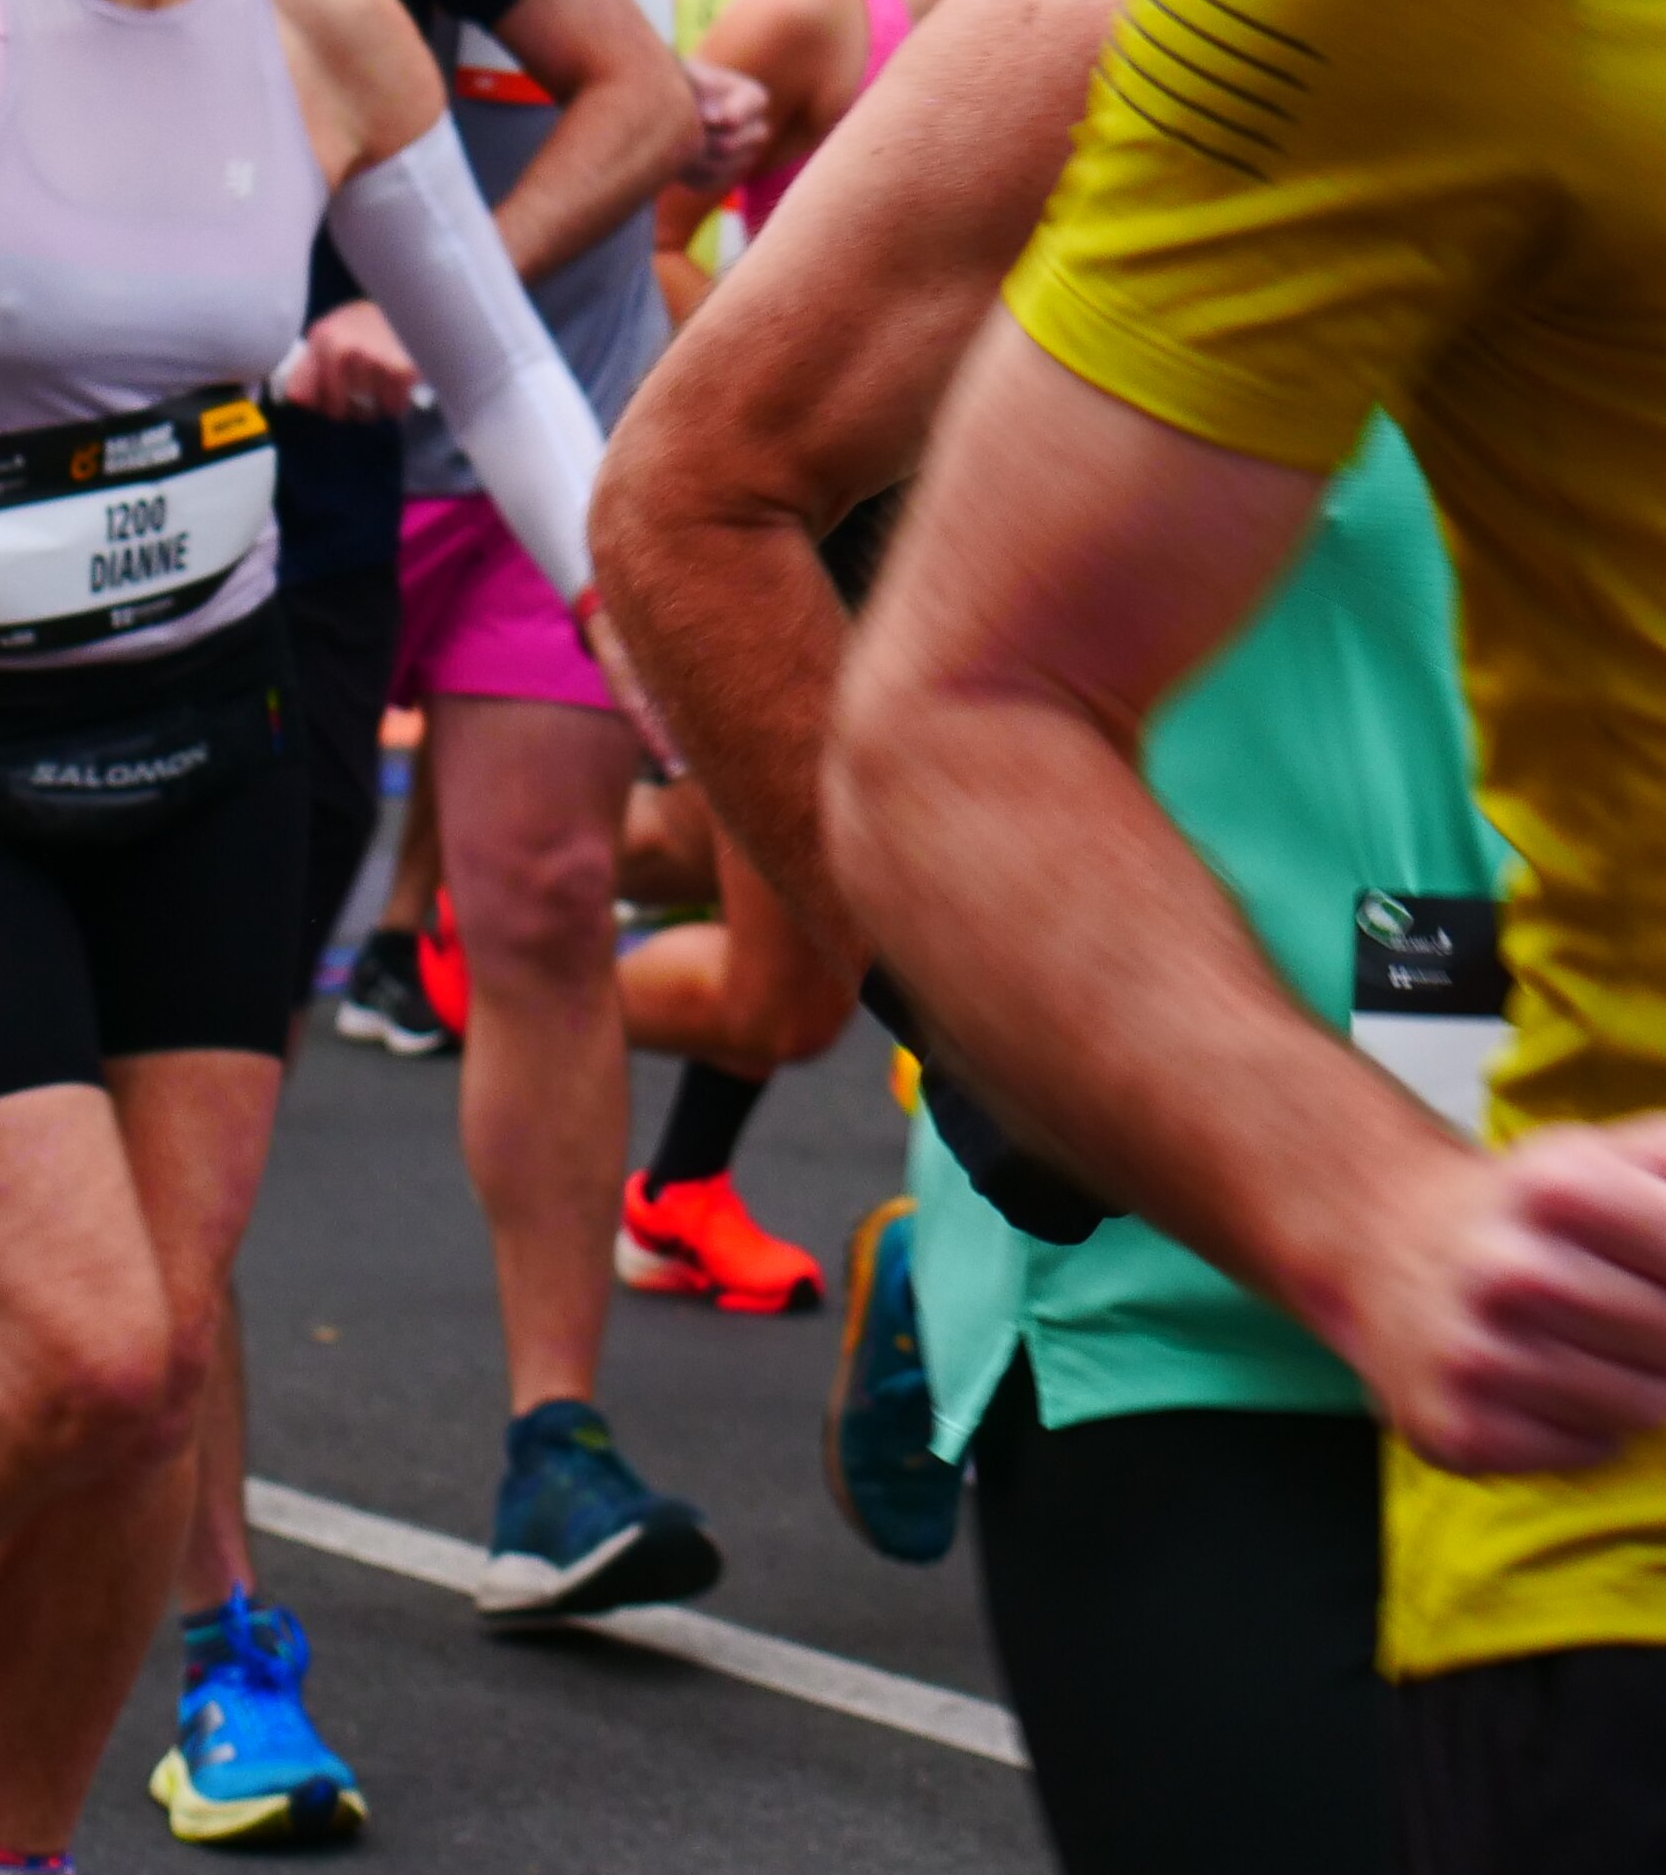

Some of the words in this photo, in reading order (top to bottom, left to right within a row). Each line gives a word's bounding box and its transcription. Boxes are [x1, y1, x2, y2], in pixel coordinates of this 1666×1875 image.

[105, 494, 168, 541] 1200
[90, 530, 191, 596] DIANNE
[31, 742, 207, 789] SALOMON
